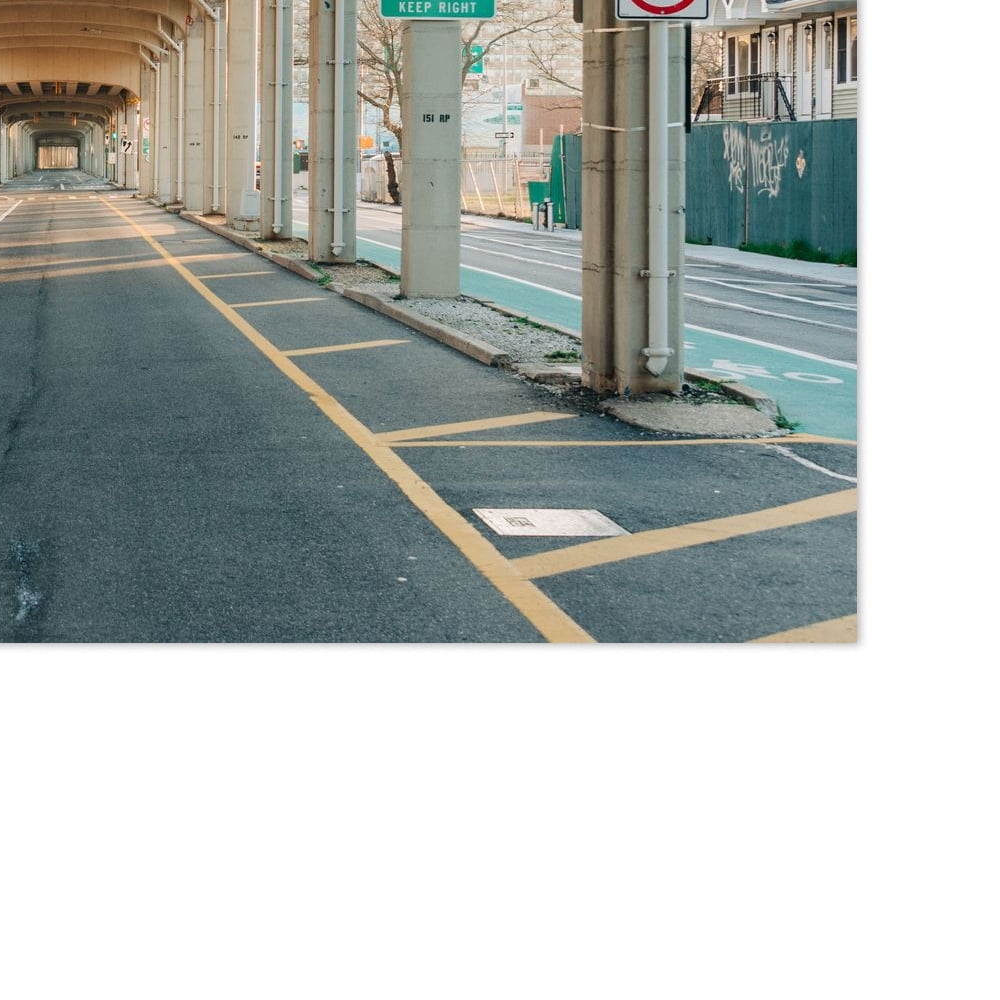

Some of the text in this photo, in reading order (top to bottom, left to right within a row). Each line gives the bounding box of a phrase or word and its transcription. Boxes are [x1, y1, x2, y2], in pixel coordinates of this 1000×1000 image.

[399, 1, 477, 13] KEEP RIGHT
[423, 114, 434, 123] 151
